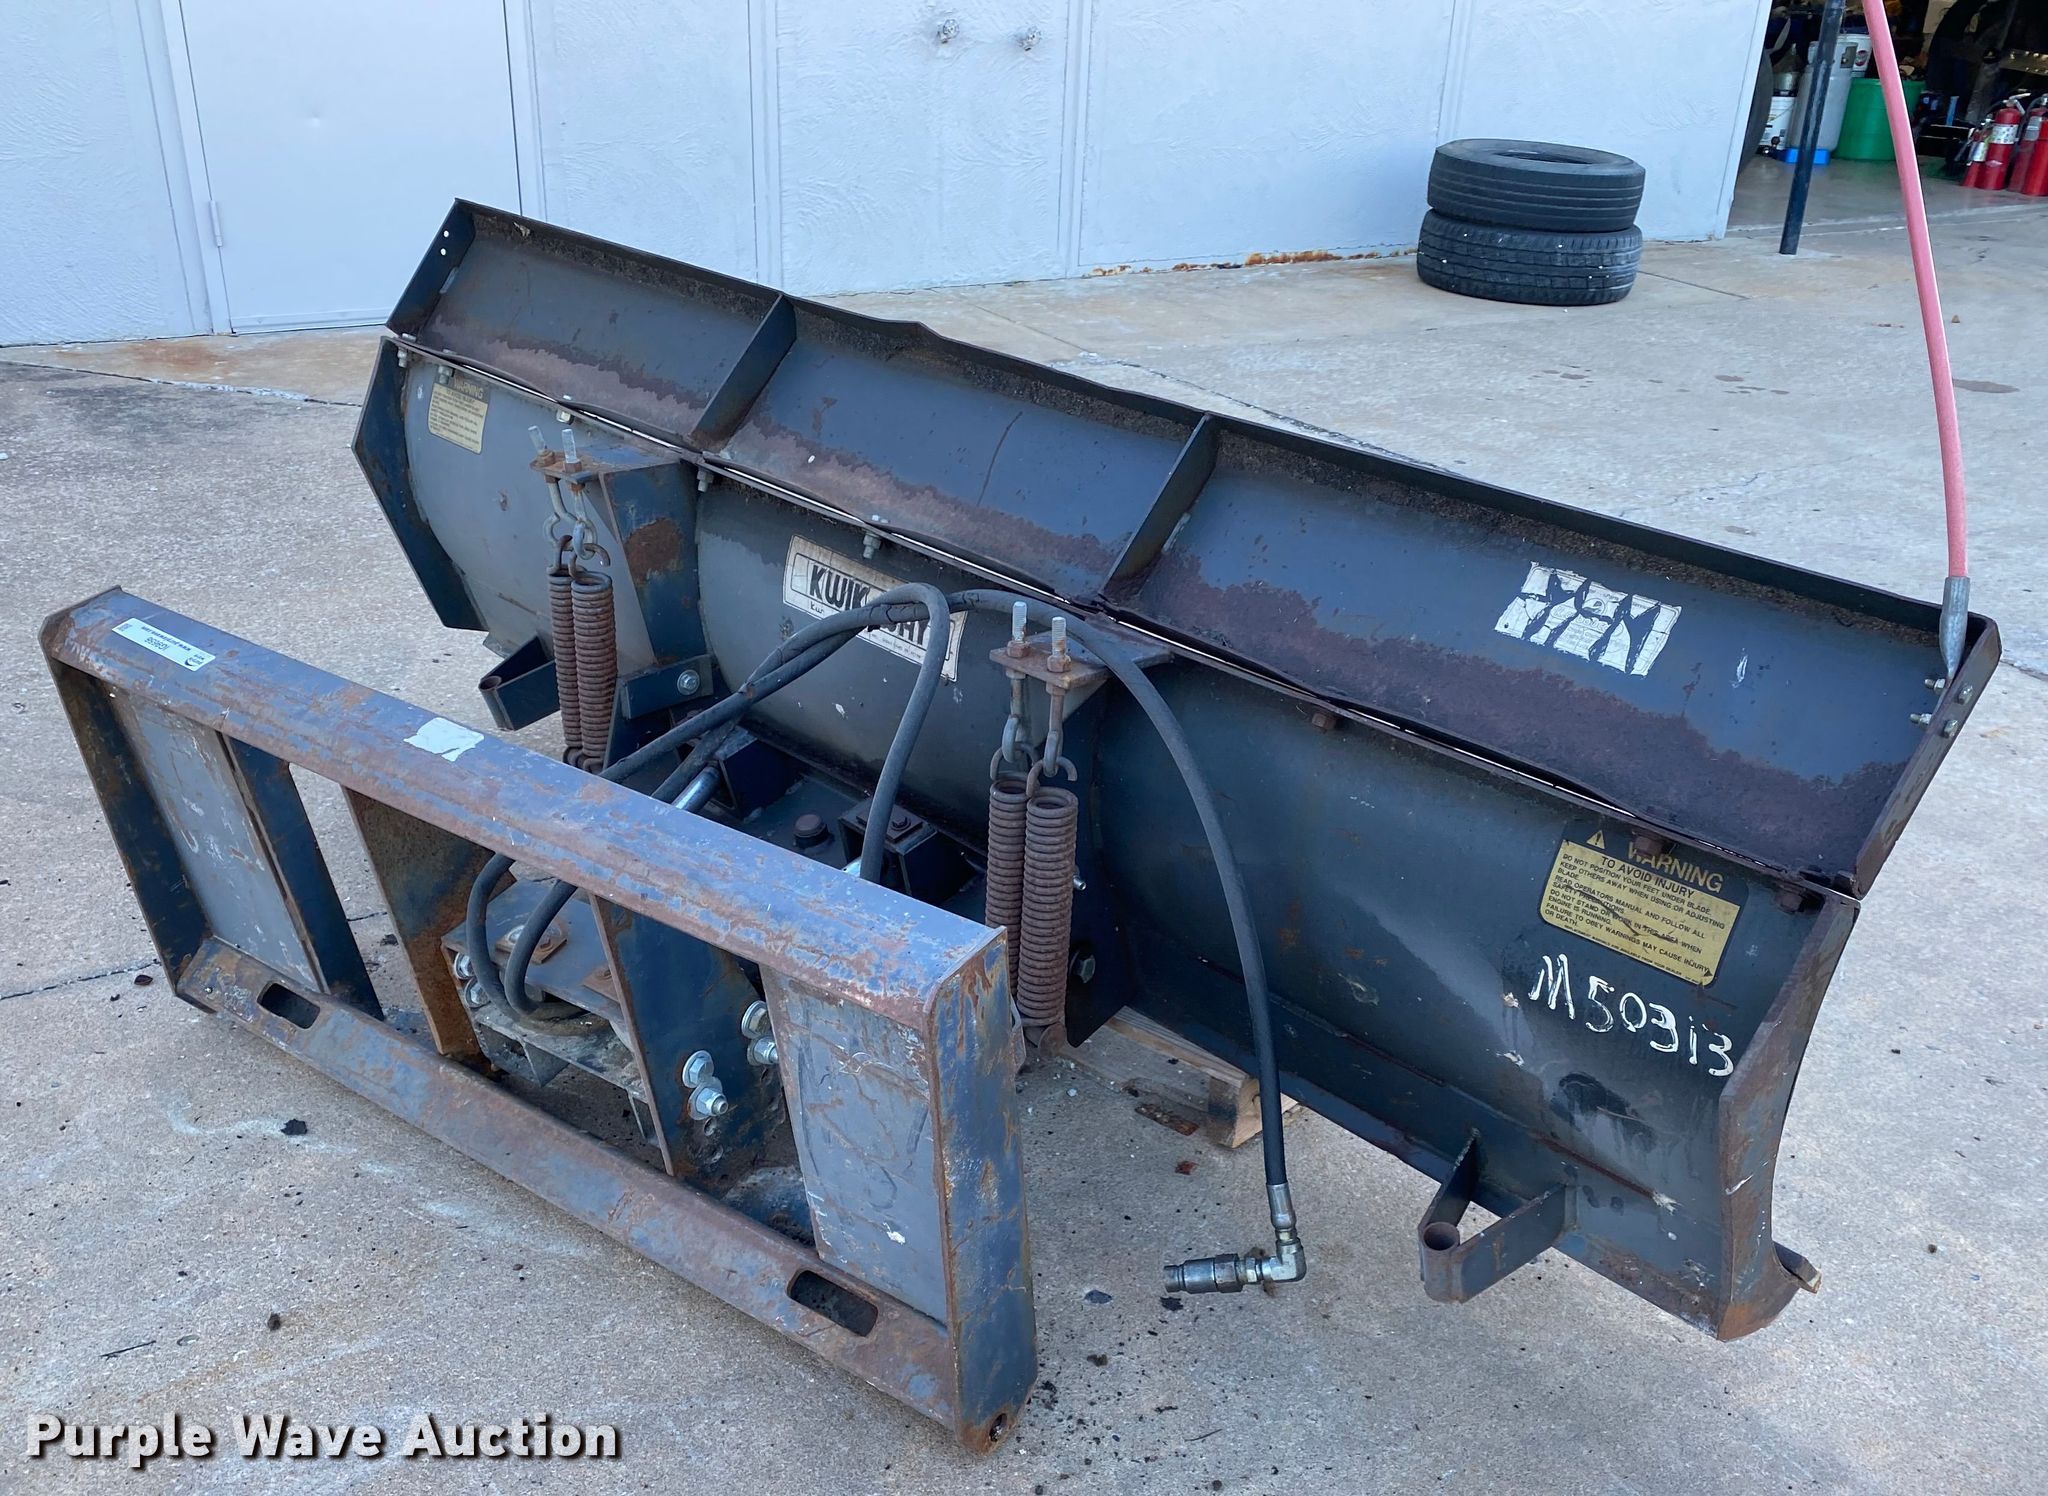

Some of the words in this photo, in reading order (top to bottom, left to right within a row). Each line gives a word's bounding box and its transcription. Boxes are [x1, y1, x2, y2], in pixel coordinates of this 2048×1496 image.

[809, 564, 870, 611] KWIK
[1562, 853, 1572, 861] DO
[1573, 858, 1587, 867] NOT
[1589, 864, 1620, 880] POSITION
[1622, 876, 1641, 888] YOUR
[1643, 884, 1659, 895] FEET
[1661, 891, 1685, 905] UNDER
[1599, 856, 1615, 868] TO
[1618, 863, 1652, 882] AVOID
[1654, 877, 1694, 898] INJURY
[1628, 841, 1724, 893] WARNING
[1544, 908, 1554, 916] OR
[1548, 895, 1571, 908] ENGINE
[1555, 875, 1572, 885] READ
[1574, 882, 1613, 901] OPERATORS
[1615, 898, 1642, 913] MANUAL
[1645, 910, 1659, 920] AND
[1661, 916, 1690, 932] FOLLOW
[1692, 929, 1705, 938] ALL
[1560, 861, 1576, 871] KEEP
[1578, 868, 1604, 882] OTHERS
[1606, 879, 1626, 890] AWAY
[1628, 887, 1648, 899] WHEN
[1650, 896, 1671, 908] USING
[1673, 904, 1683, 913] OR
[1685, 909, 1725, 929] ADJUSTING
[1546, 902, 1572, 917] FAILURE
[1585, 918, 1603, 929] OBEY
[1604, 926, 1640, 945] WARNINGS
[1642, 941, 1657, 951] MAY
[1659, 948, 1681, 961] CAUSE
[1561, 893, 1575, 902] NOT
[1576, 899, 1598, 912] STAND
[1680, 941, 1702, 953] WHEN
